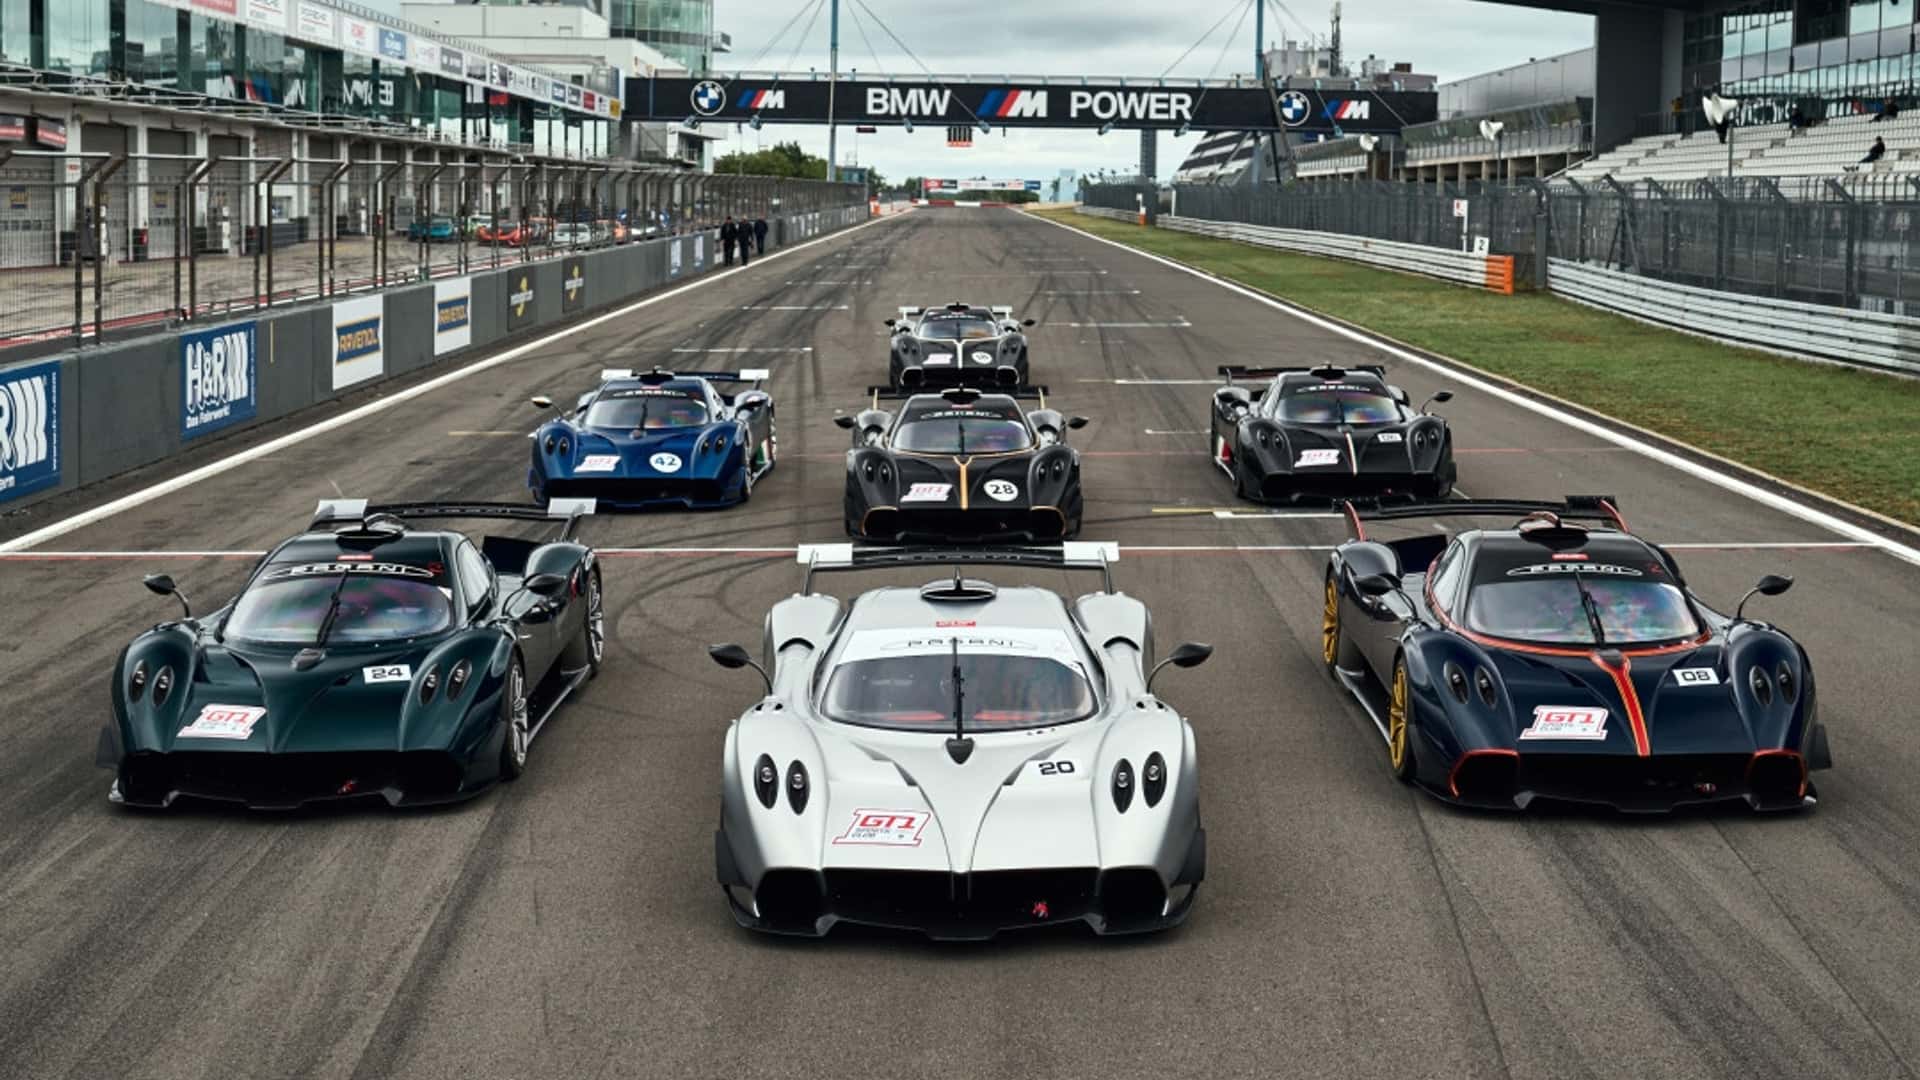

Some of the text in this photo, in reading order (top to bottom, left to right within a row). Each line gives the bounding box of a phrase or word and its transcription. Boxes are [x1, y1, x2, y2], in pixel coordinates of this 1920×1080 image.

[866, 88, 952, 116] BMW
[1070, 91, 1192, 120] POWER
[1479, 239, 1486, 251] 2
[340, 328, 378, 351] RAVENOL
[186, 336, 229, 414] H&R
[655, 456, 677, 466] 42
[990, 484, 1014, 495] 28
[371, 667, 402, 679] 24
[1681, 671, 1711, 681] 08
[206, 710, 250, 723] GT1
[1545, 712, 1594, 724] GT1
[1038, 761, 1075, 776] 20
[860, 815, 915, 829] GT1
